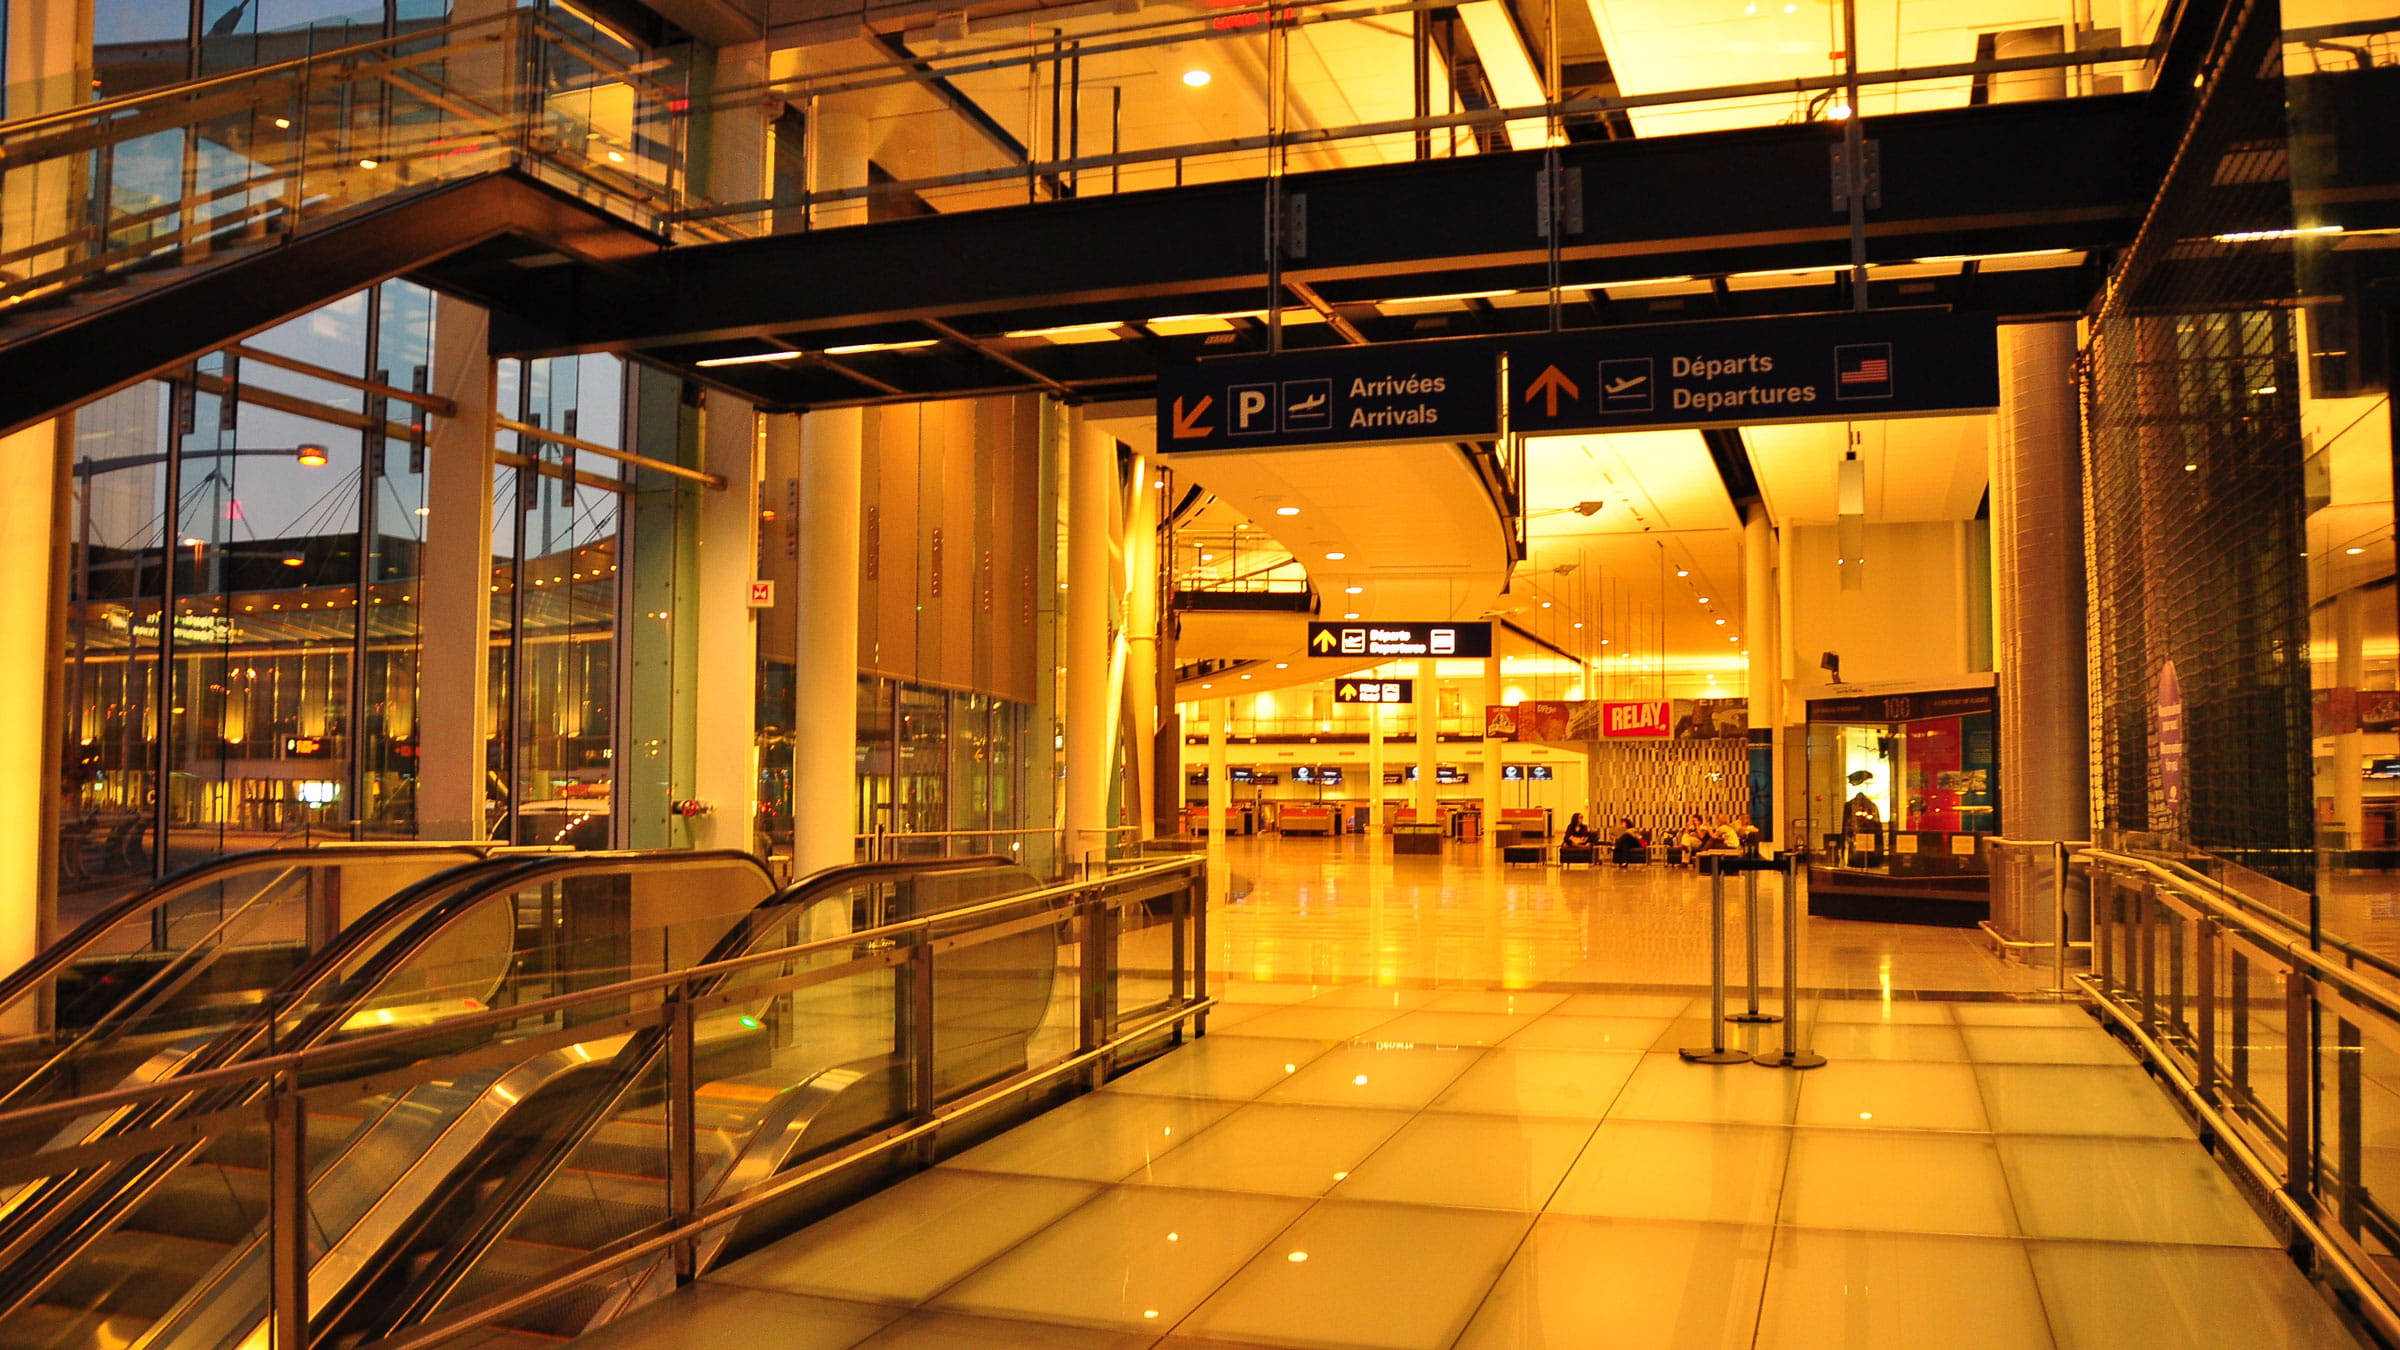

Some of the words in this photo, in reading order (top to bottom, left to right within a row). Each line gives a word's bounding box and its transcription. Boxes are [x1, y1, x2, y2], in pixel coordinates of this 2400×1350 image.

[1672, 353, 1773, 380] Départs
[1349, 374, 1446, 398] Arrivées
[1673, 386, 1816, 412] Departures
[1239, 390, 1266, 428] P
[1349, 404, 1438, 428] Arrivals
[1612, 702, 1663, 731] RELAY
